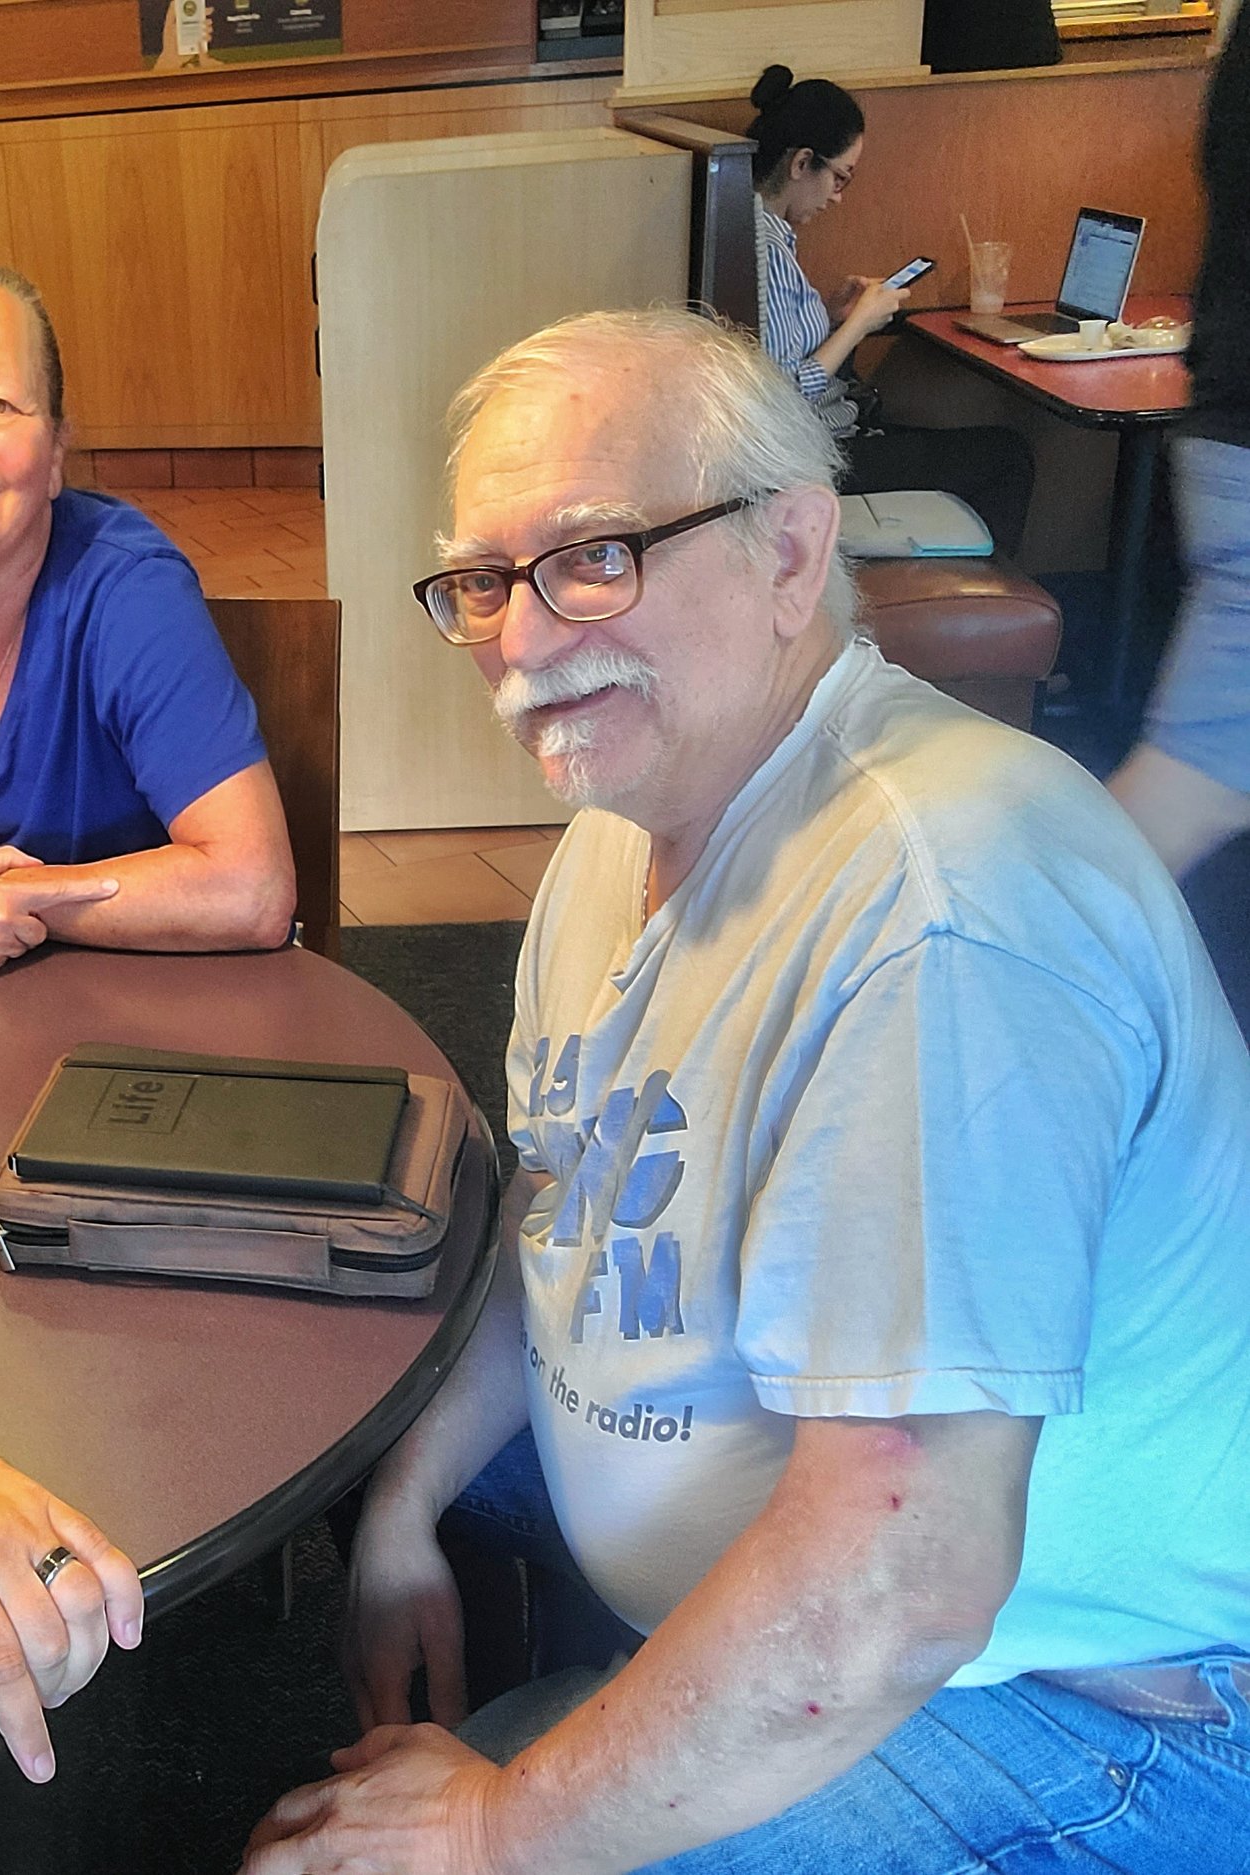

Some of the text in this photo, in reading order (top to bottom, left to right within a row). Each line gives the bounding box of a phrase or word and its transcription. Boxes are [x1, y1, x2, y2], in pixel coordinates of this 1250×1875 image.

[109, 1081, 164, 1124] Life
[568, 1230, 687, 1345] FM
[549, 1366, 579, 1413] the
[585, 1400, 693, 1442] radio!
